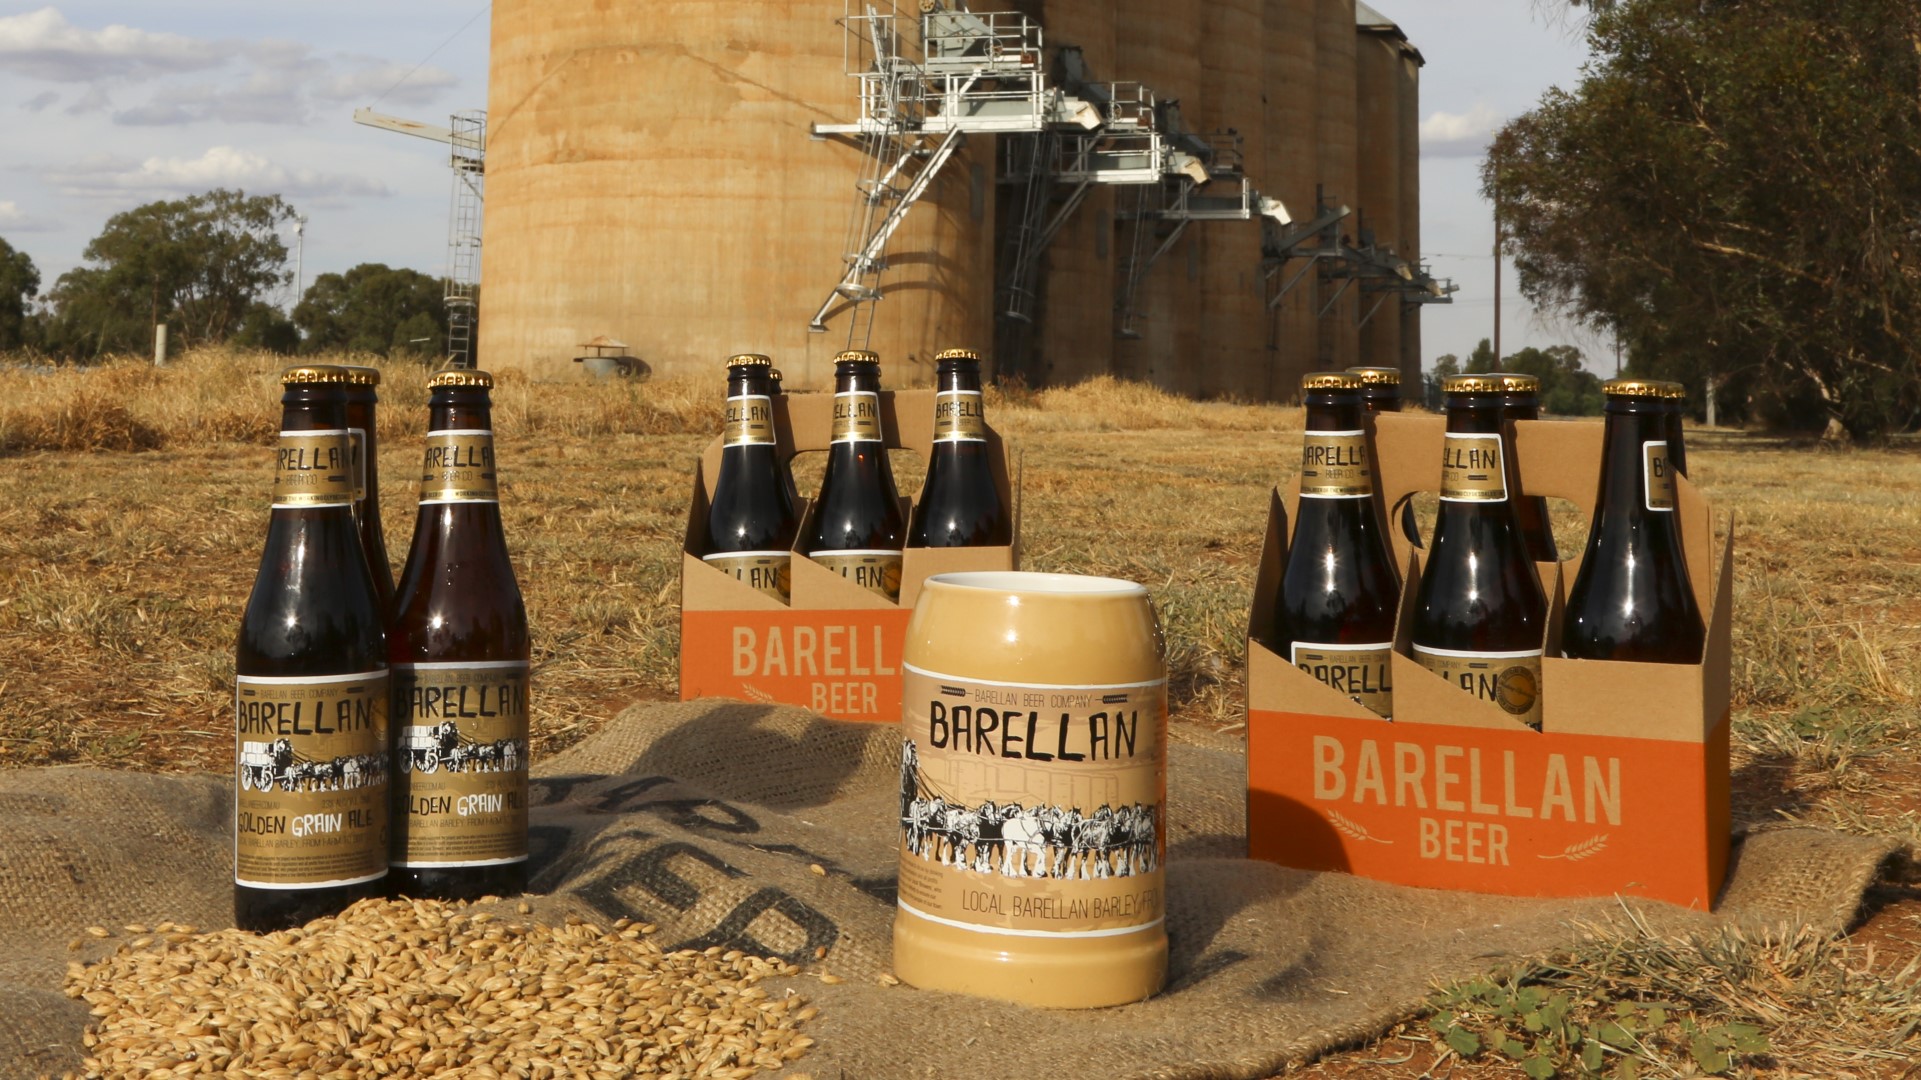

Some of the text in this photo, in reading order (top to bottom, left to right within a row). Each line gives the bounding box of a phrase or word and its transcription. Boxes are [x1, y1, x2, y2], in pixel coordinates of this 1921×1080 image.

[733, 625, 902, 677] BARELL
[260, 687, 340, 700] BARELLAN BEER COMPANY
[396, 685, 524, 718] BARELLAN
[812, 682, 878, 714] BEER
[975, 688, 1093, 709] BARELLAN BEER COMPANY
[239, 697, 373, 736] BARELLAN
[930, 700, 1138, 762] BARELLAN
[1313, 735, 1621, 826] BARELLAN
[457, 793, 503, 817] GRAIN
[238, 811, 286, 836] GOLDEN
[291, 812, 343, 838] GRAIN
[348, 809, 374, 829] ALE
[1419, 817, 1510, 866] BEER
[962, 889, 1007, 916] LOCAL
[1013, 896, 1089, 920] BARELLAN
